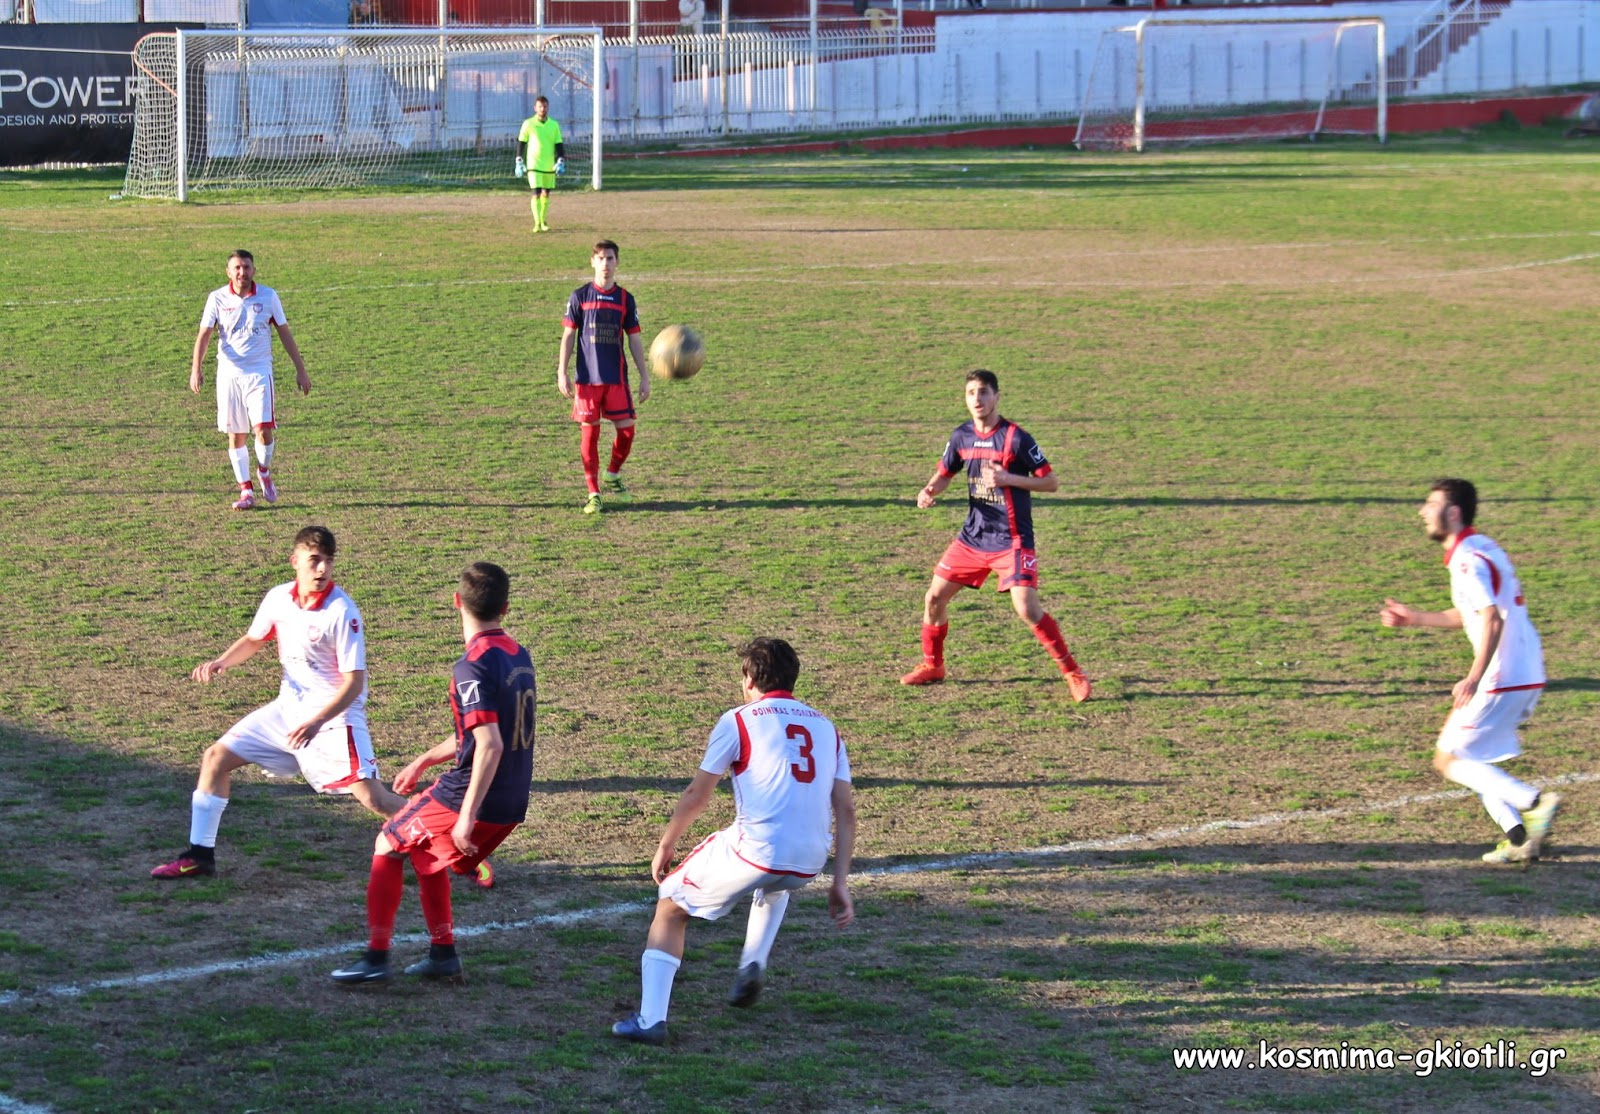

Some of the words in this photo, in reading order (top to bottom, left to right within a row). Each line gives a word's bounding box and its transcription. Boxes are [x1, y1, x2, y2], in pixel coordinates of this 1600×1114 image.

[0, 114, 45, 126] DESIGN
[49, 114, 76, 125] AND
[512, 688, 535, 751] 10
[785, 723, 816, 784] 3
